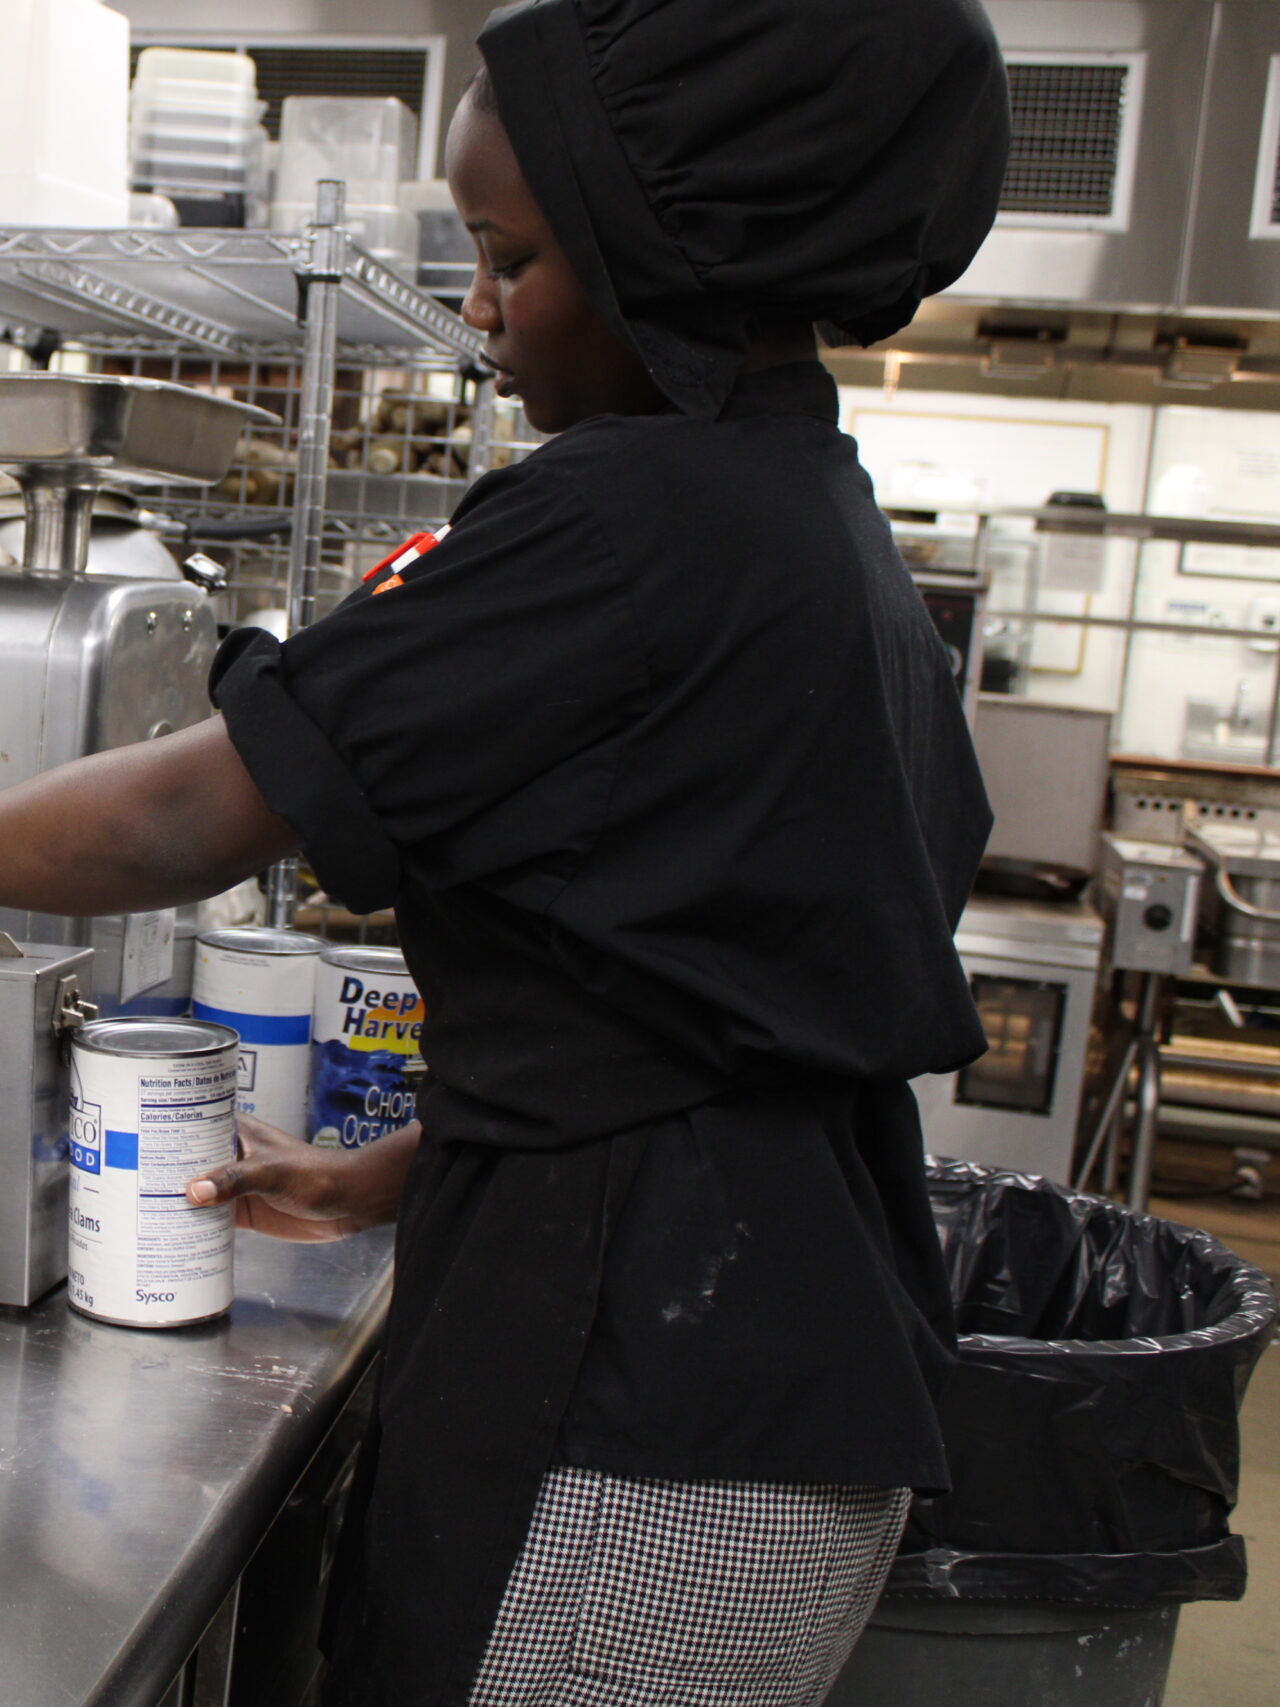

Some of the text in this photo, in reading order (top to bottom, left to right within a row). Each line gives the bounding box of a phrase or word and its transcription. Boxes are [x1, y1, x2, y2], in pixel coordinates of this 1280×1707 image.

[339, 976, 418, 1016] Deep
[141, 1078, 172, 1089] Nutrition
[73, 1207, 101, 1233] Clams
[136, 1288, 175, 1305] Sysco
